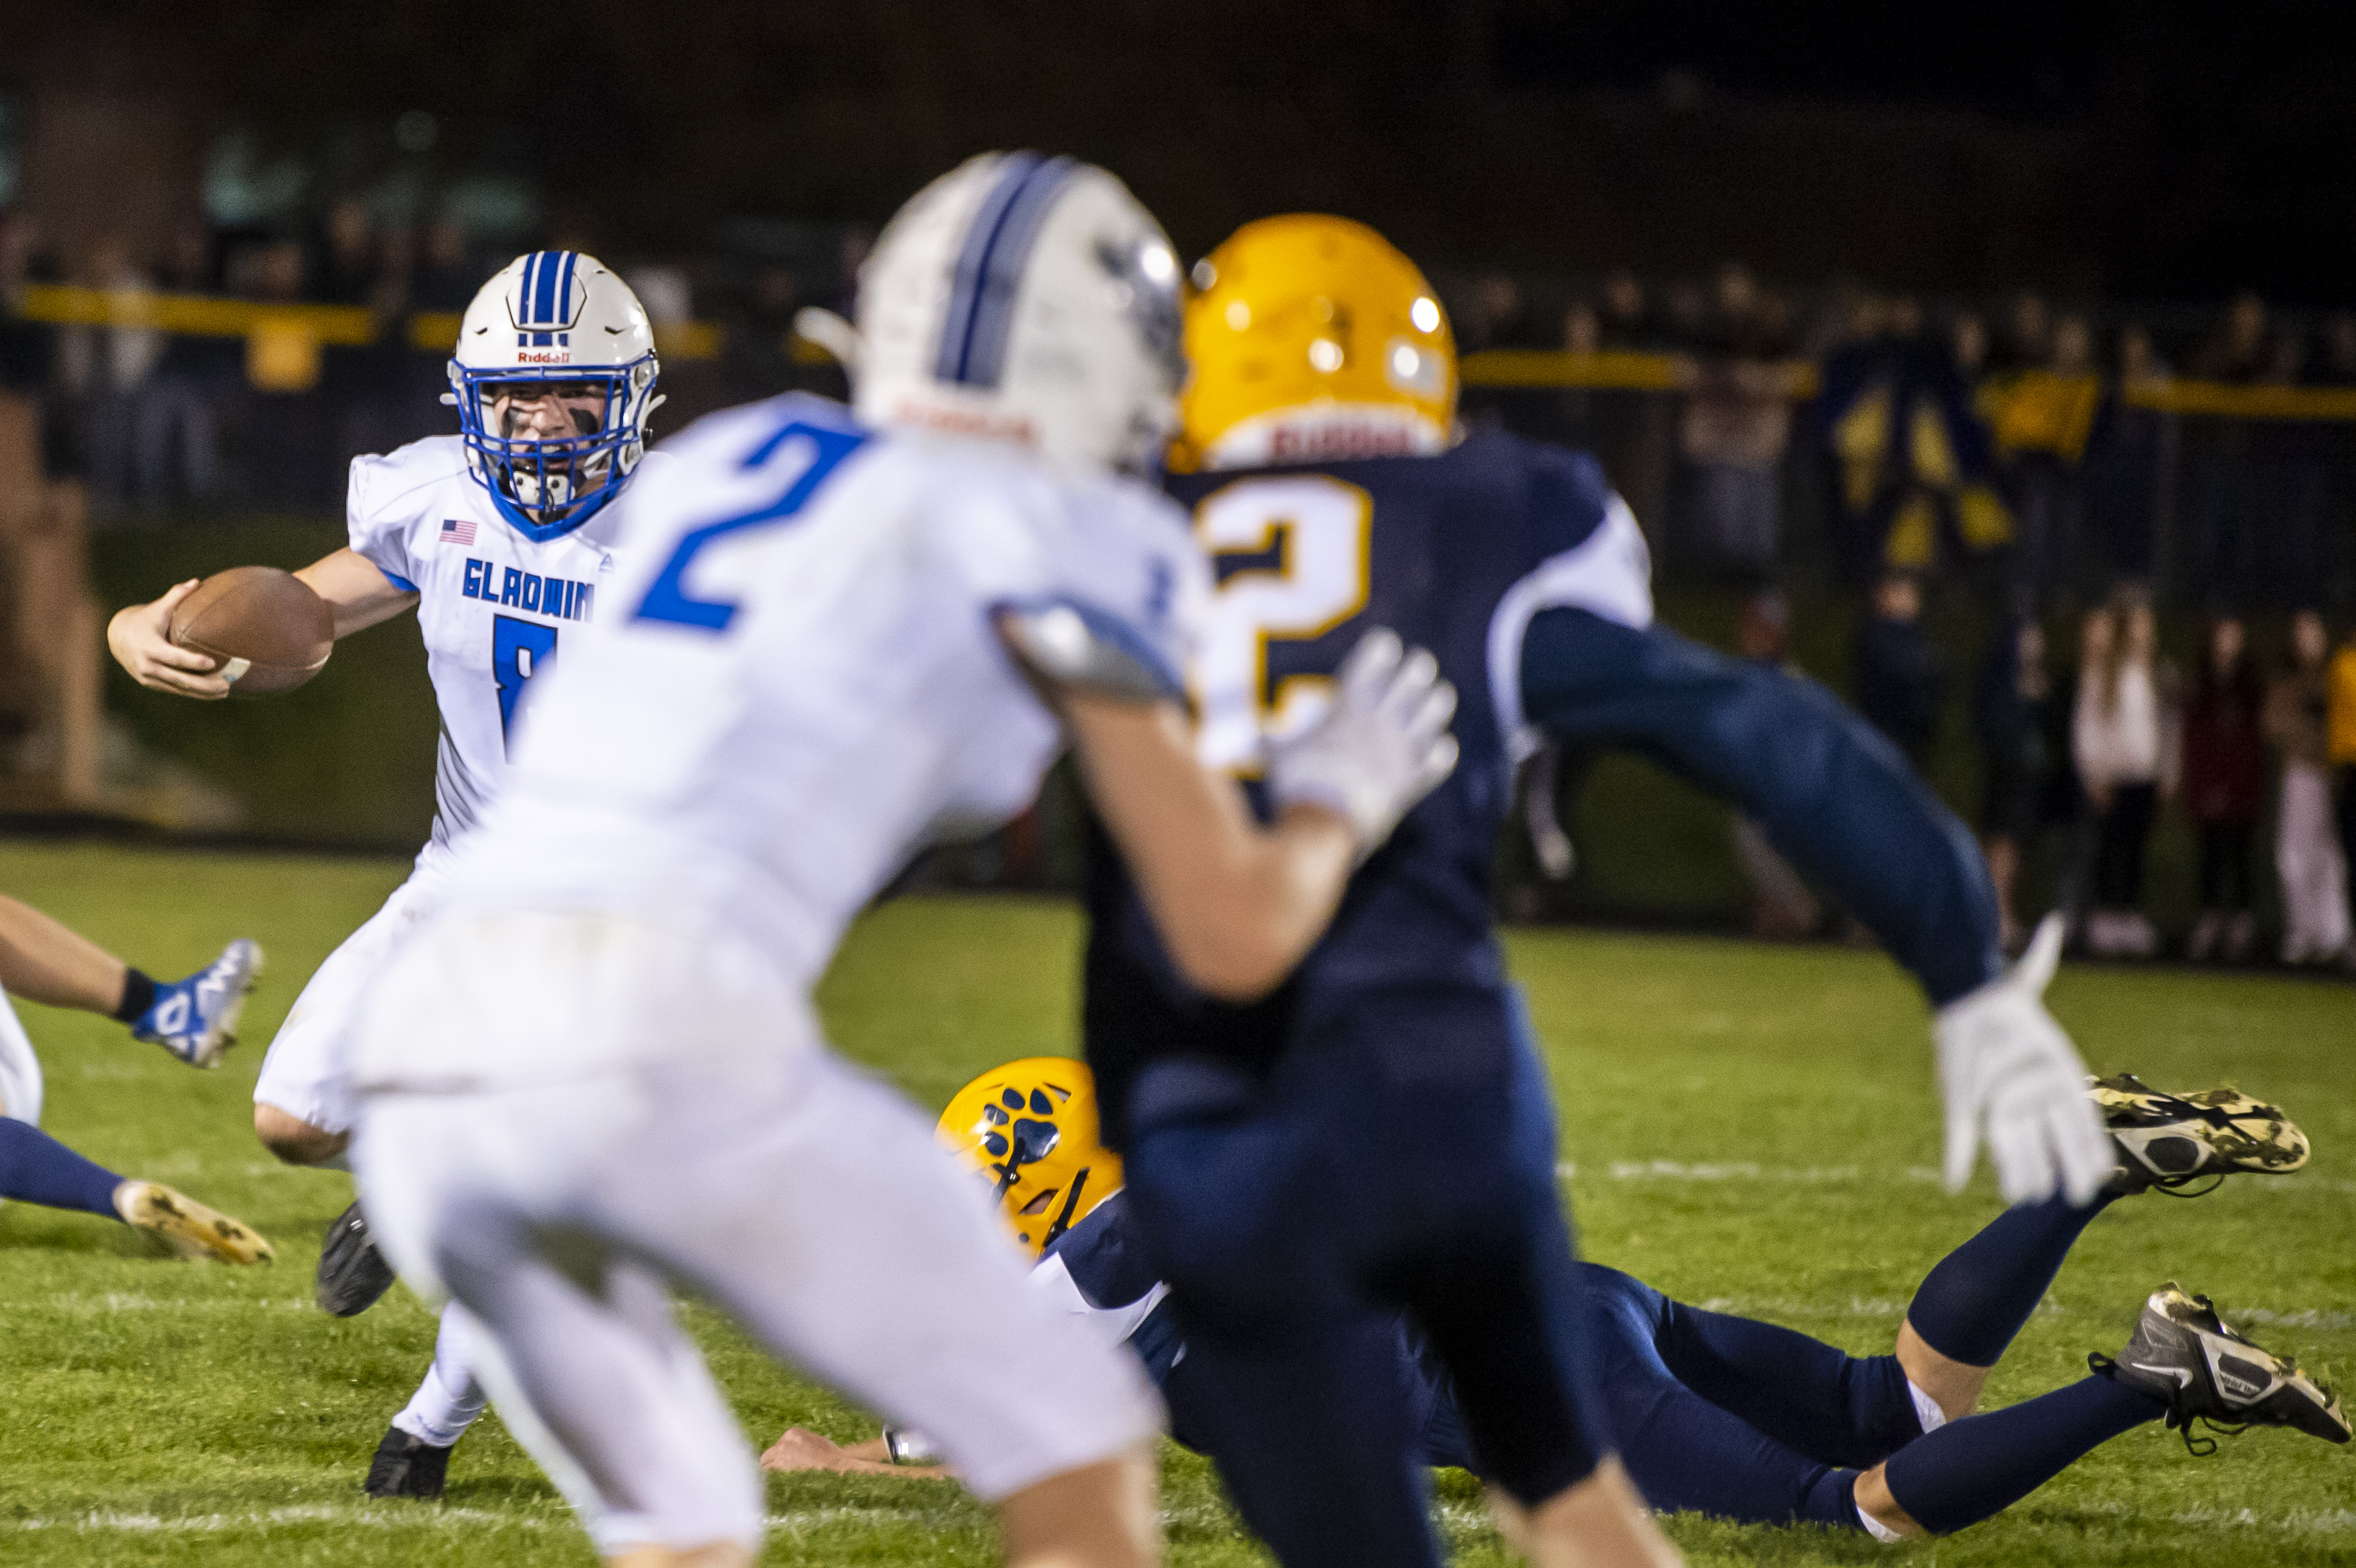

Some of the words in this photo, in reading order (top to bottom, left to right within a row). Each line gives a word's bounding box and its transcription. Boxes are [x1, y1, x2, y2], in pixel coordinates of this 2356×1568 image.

[463, 557, 595, 623] GLADWIN
[629, 420, 870, 632] 2
[1192, 474, 1375, 781] 2
